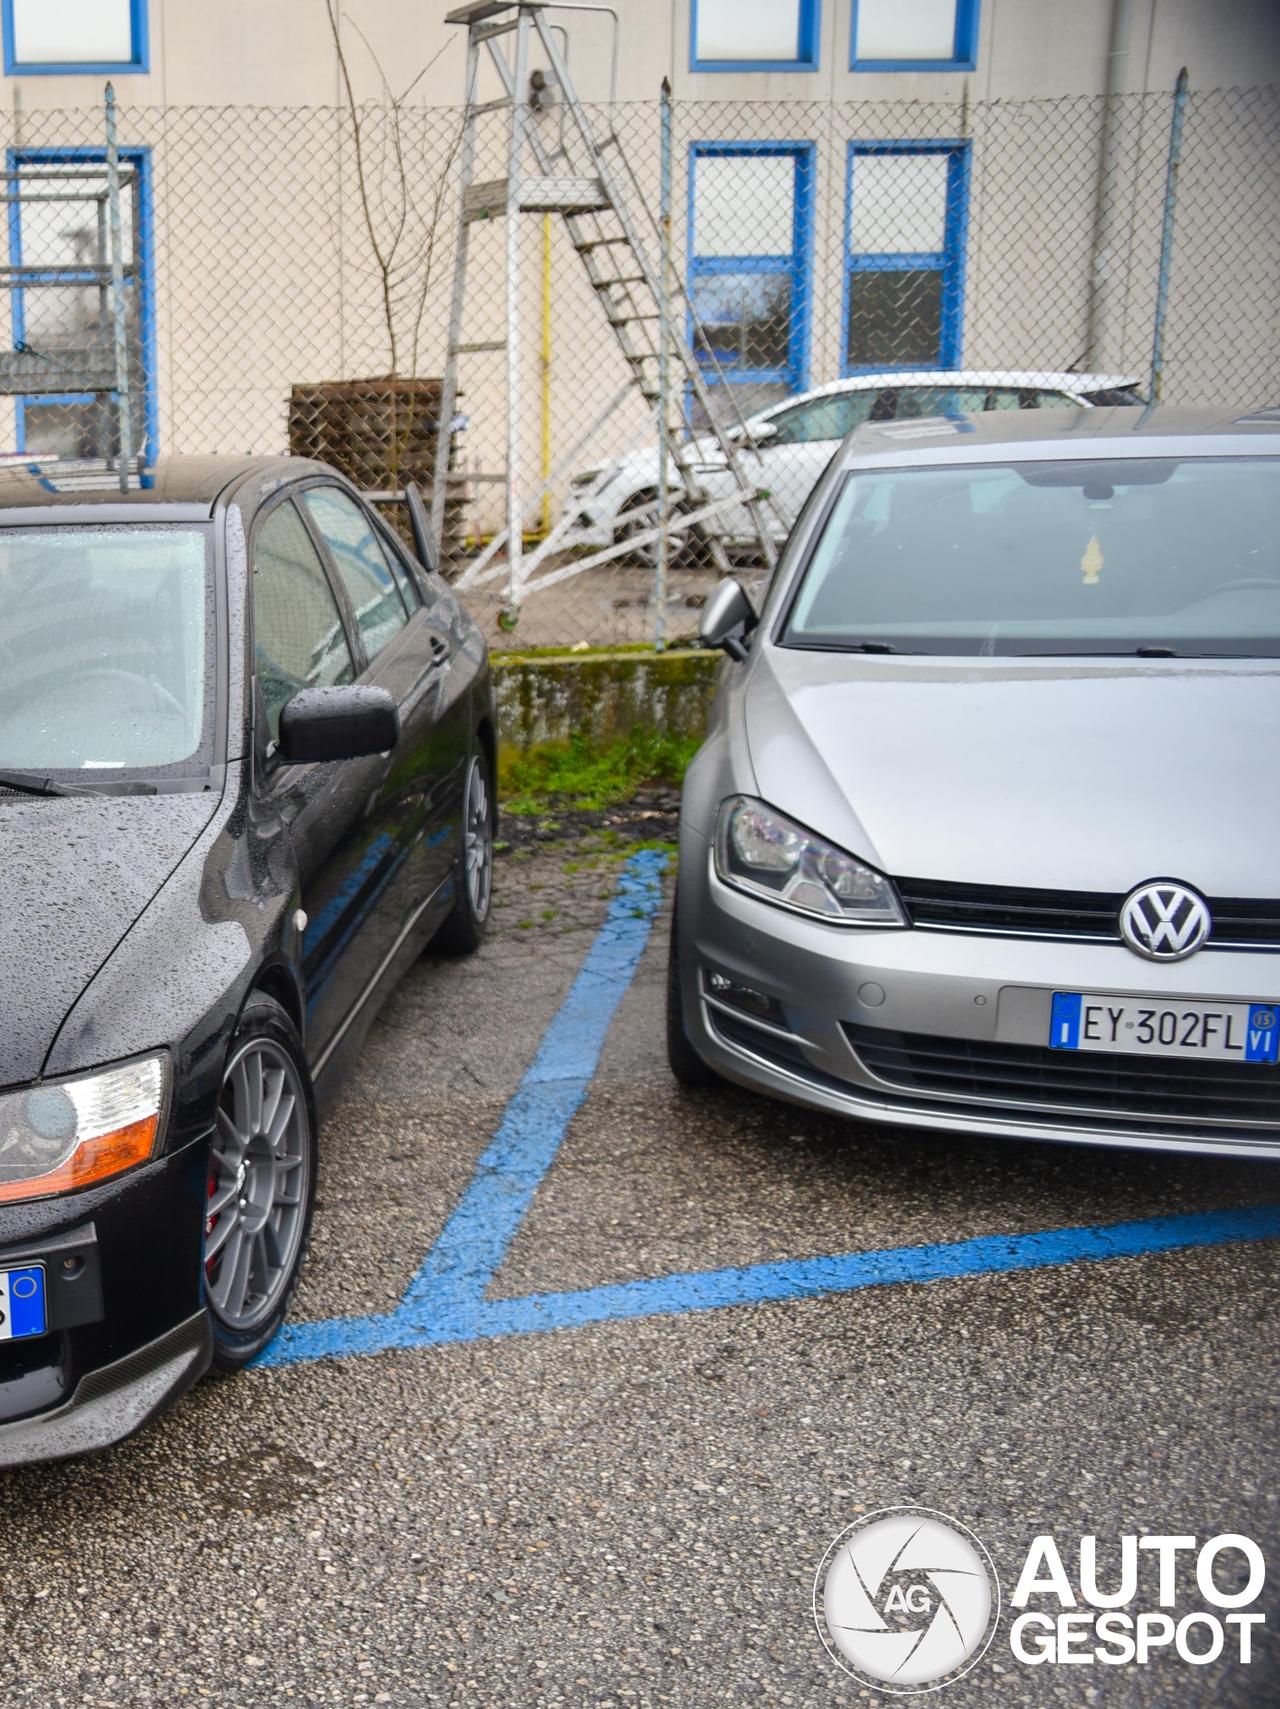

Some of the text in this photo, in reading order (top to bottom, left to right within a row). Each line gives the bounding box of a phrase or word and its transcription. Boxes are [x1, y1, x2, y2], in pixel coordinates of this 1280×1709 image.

[1122, 886, 1208, 956] VW
[1060, 1022, 1069, 1043] I
[1083, 1006, 1244, 1050] EY 302FL
[1250, 1030, 1272, 1052] VI
